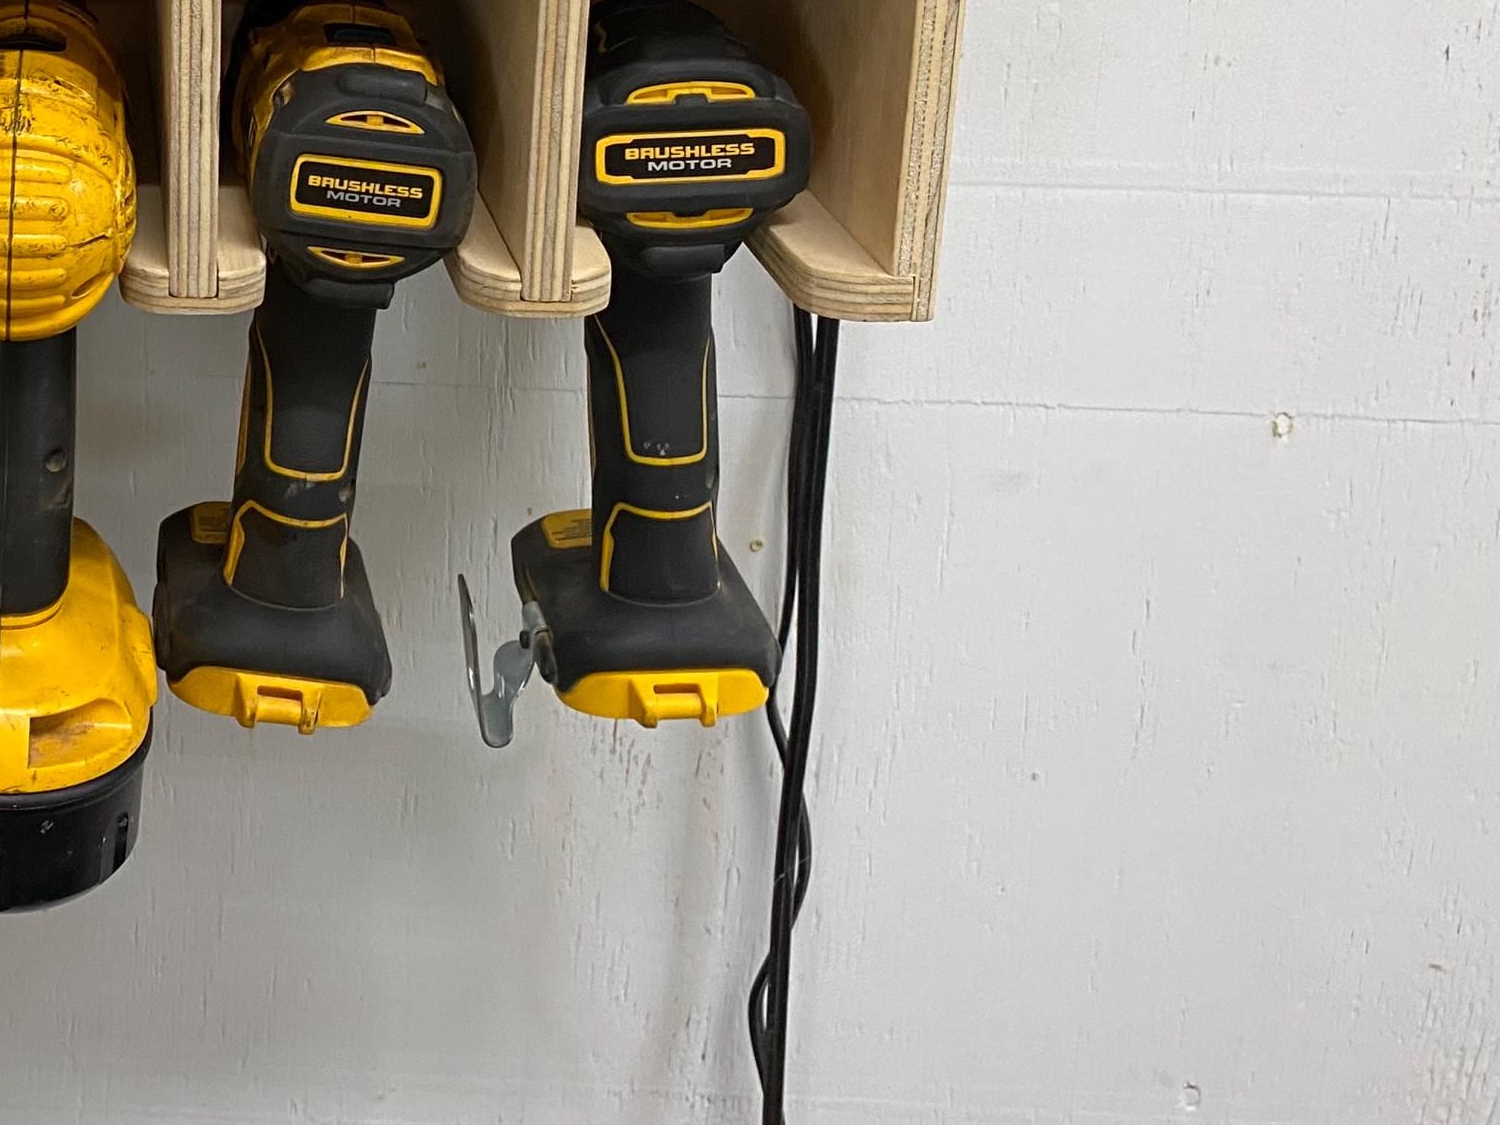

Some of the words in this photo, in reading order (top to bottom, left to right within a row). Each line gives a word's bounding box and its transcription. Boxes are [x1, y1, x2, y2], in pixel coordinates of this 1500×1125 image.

[625, 143, 755, 160] BRUSHLESS
[648, 159, 732, 171] MOTOR
[308, 175, 423, 199] BRUSHLESS
[327, 190, 400, 207] MOTOR
